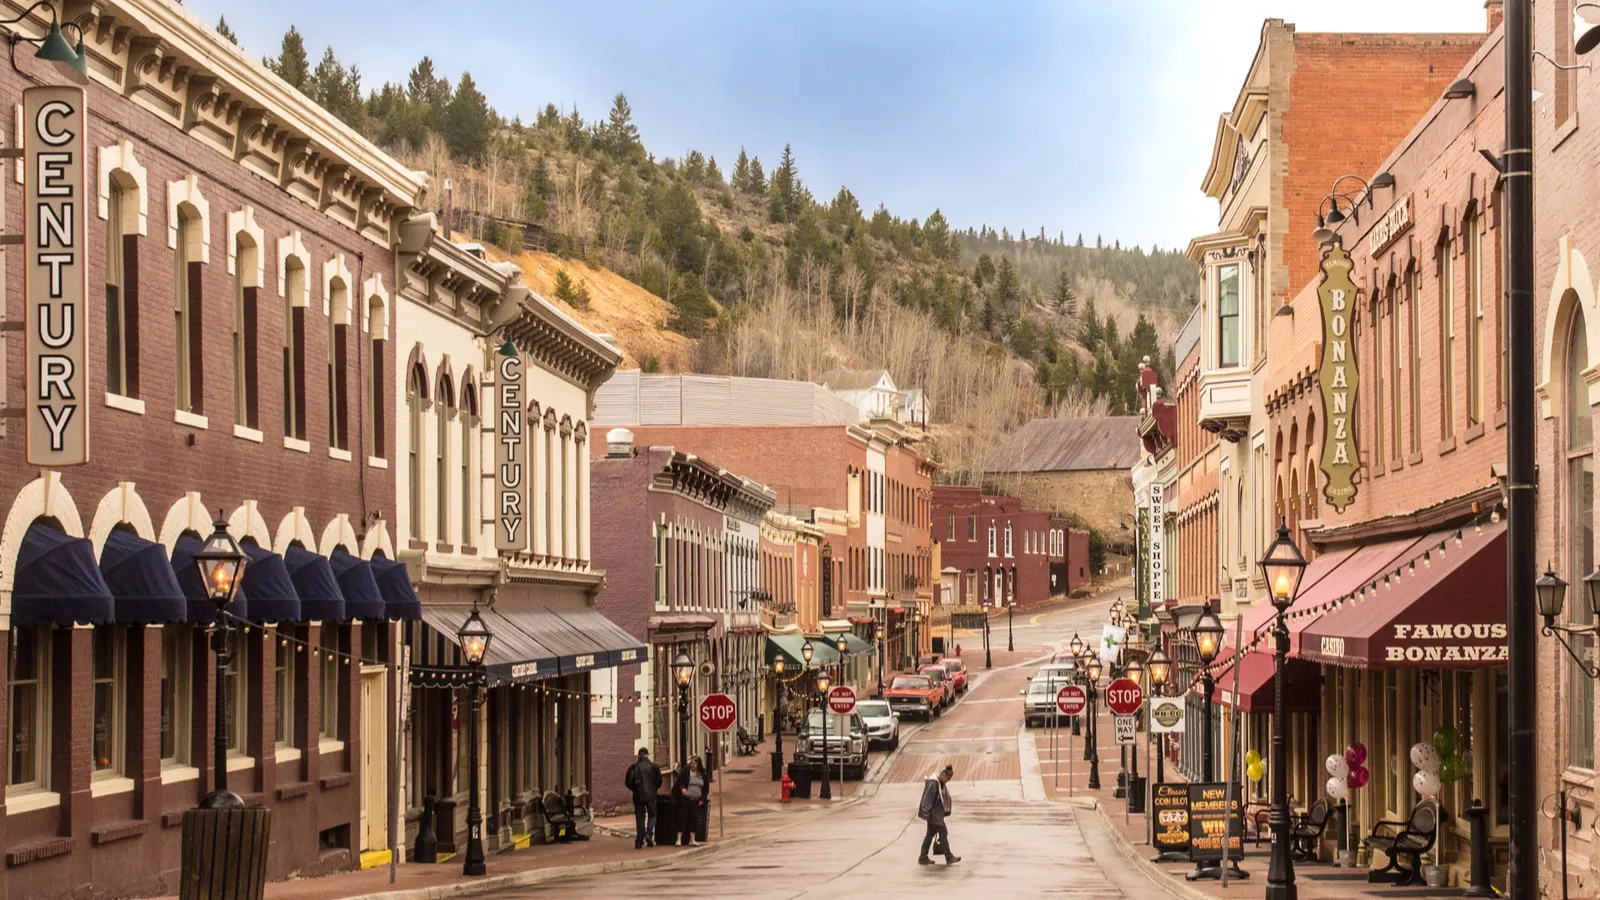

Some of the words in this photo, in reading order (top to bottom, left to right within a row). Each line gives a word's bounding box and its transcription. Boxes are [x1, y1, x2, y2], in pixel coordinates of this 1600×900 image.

[1324, 259, 1351, 269] FAMOUS
[36, 100, 77, 451] CENTURY
[1331, 289, 1349, 464] BONANZA
[501, 356, 522, 543] CENTURY
[1328, 486, 1353, 496] CASINO
[1151, 486, 1162, 532] SWEET
[1152, 542, 1161, 599] SHOPPE
[1394, 623, 1507, 639] FAMOUS
[1321, 636, 1345, 658] CASINO
[1385, 645, 1508, 661] BONANZA
[1109, 689, 1140, 704] STOP
[702, 705, 733, 720] STOP
[1117, 718, 1133, 726] ONE
[1154, 797, 1171, 806] COIN
[1202, 789, 1225, 799] NEW
[1201, 820, 1225, 834] WIN
[1212, 837, 1220, 848] IN
